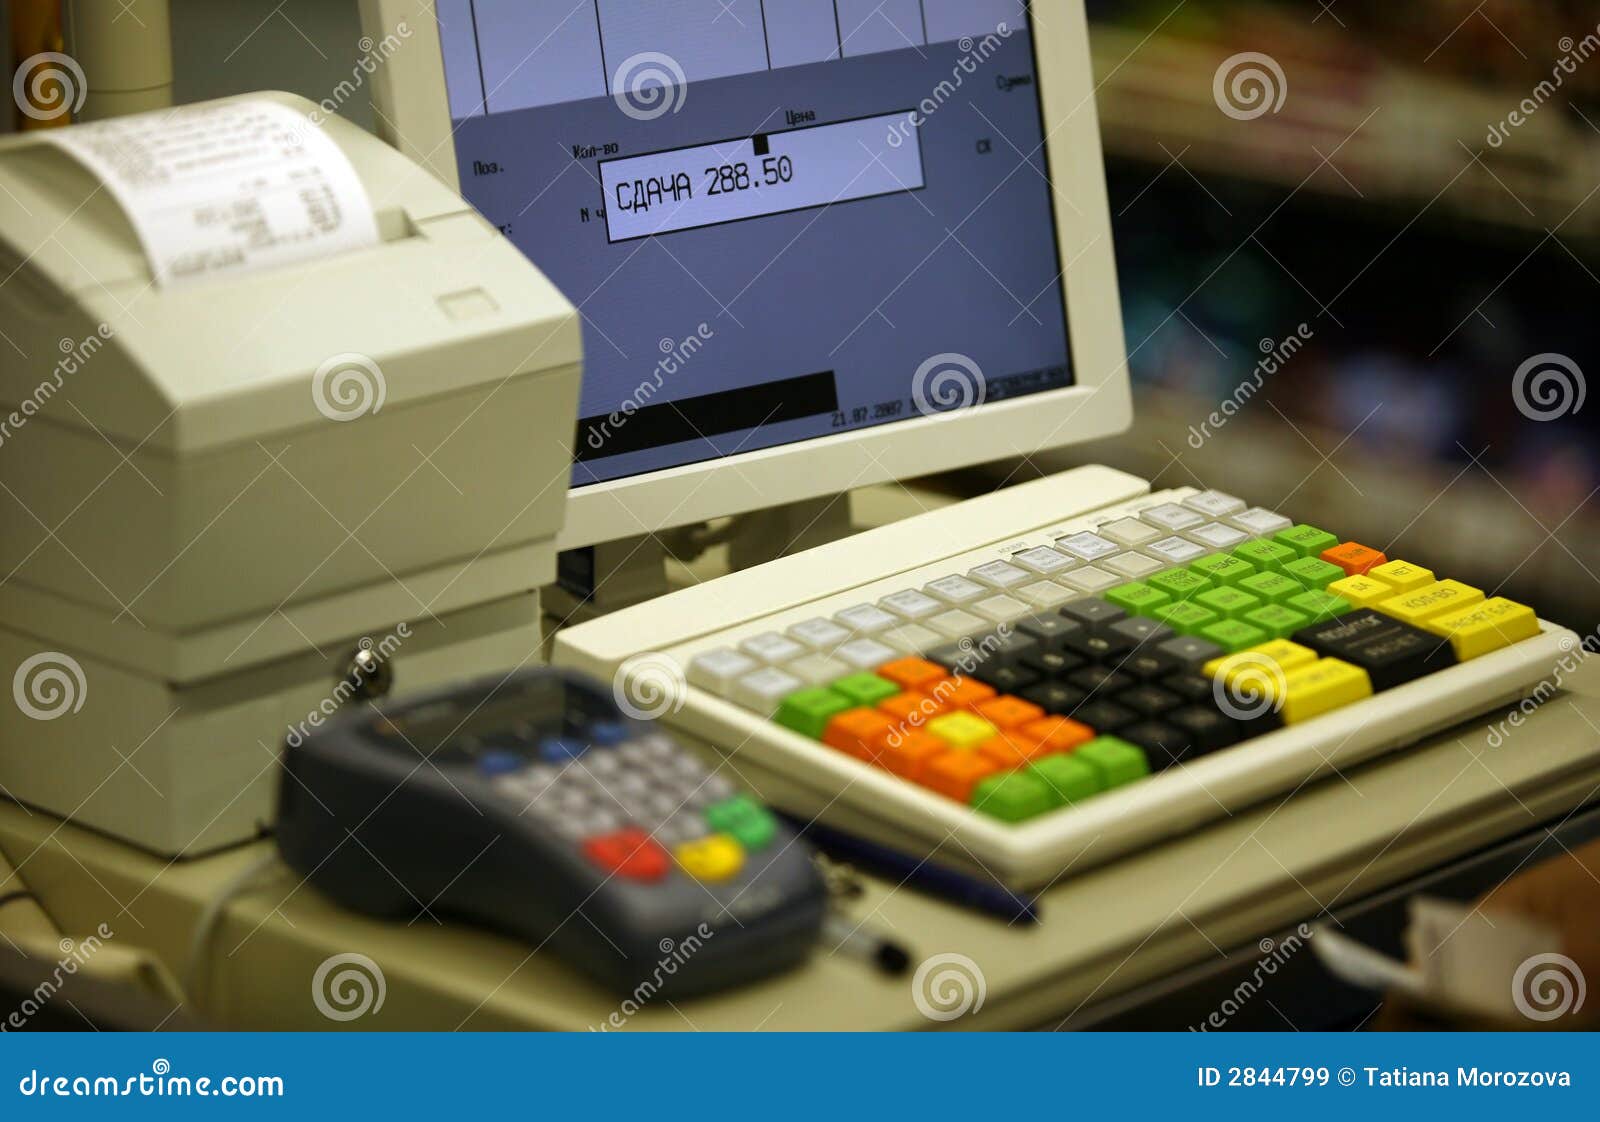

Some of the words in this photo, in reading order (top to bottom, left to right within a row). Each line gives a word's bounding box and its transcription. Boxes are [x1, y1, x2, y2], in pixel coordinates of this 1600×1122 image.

[785, 109, 816, 127] Цена
[573, 143, 619, 160] Кол-во
[473, 160, 504, 176] Поз.
[616, 172, 692, 213] СДАЧА
[705, 155, 792, 196] 288.50
